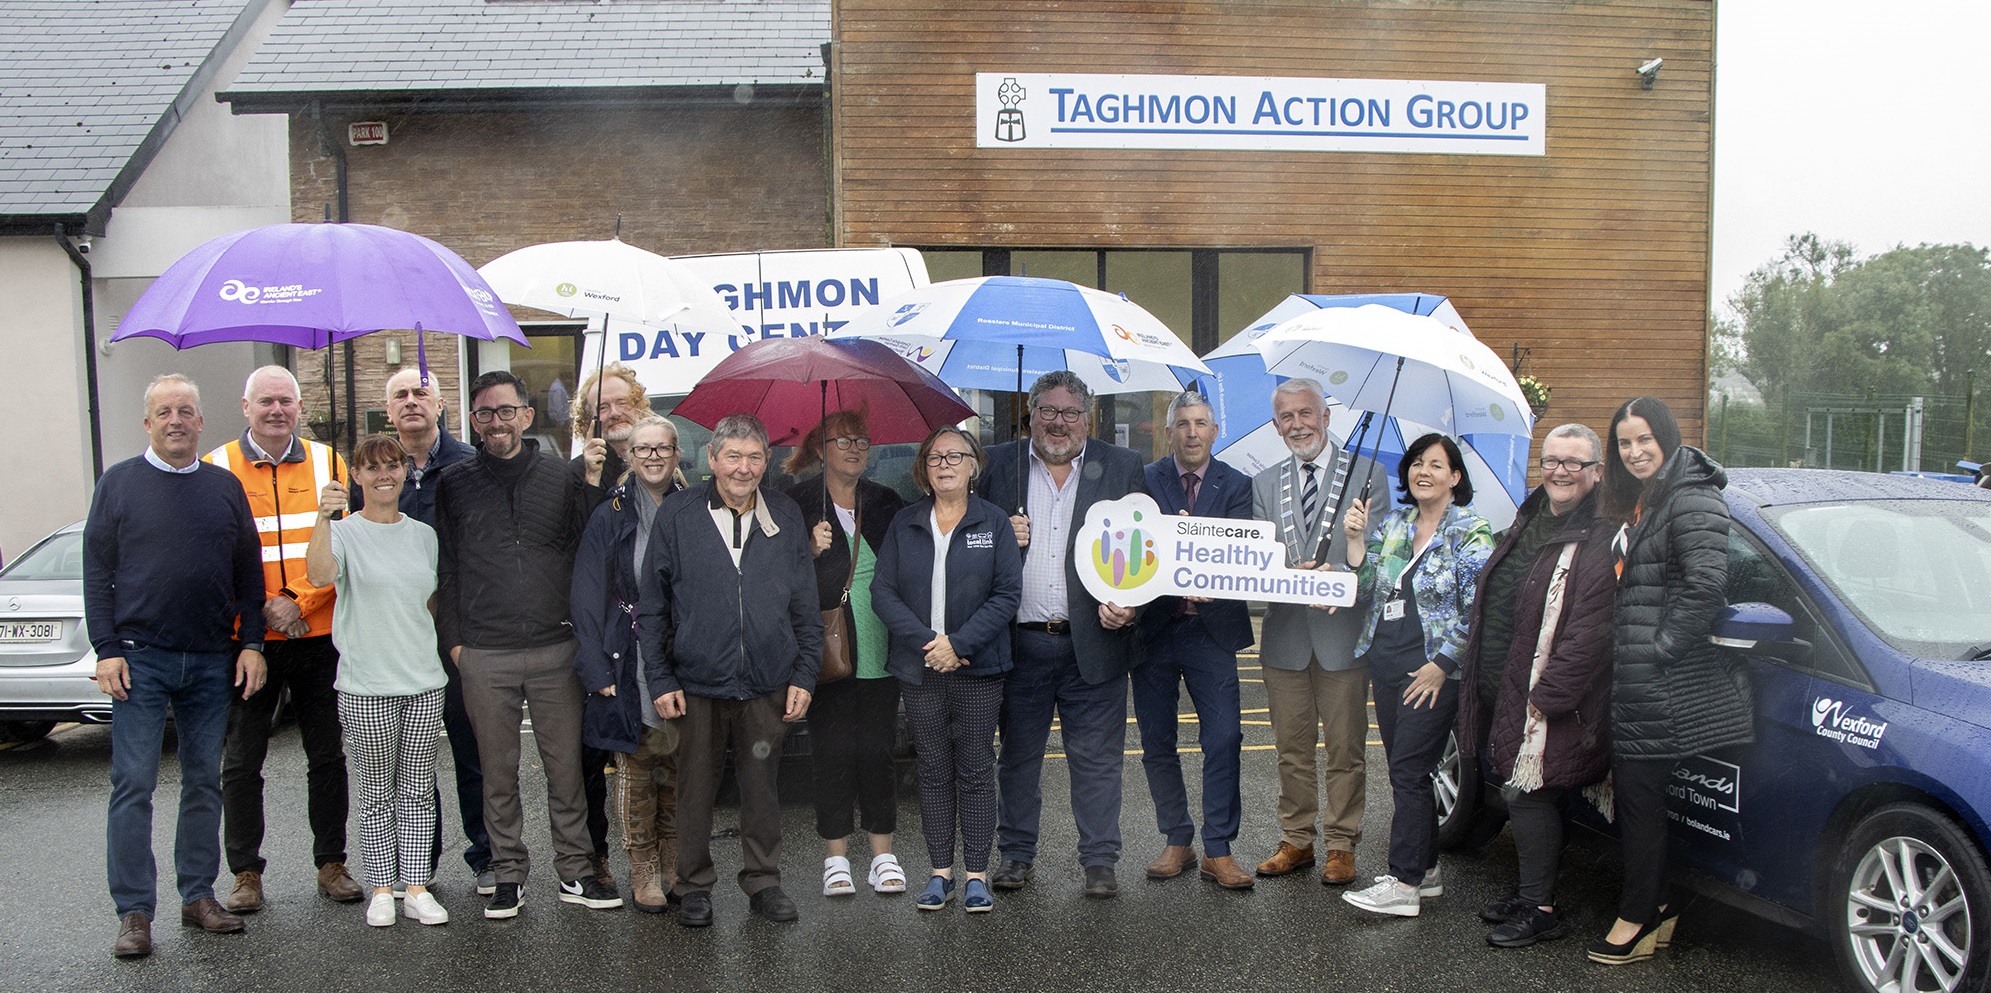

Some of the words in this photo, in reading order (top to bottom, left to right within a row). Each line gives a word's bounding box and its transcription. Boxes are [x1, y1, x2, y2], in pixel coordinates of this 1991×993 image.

[1049, 87, 1237, 125] TAGHMON
[1252, 90, 1391, 127] ACTION
[1407, 93, 1529, 130] GROUP
[584, 291, 620, 302] Wexford
[1011, 320, 1047, 329] Municipal
[1048, 324, 1075, 332] District
[619, 330, 706, 361] DAY
[1175, 540, 1273, 571] Healthy
[1173, 566, 1346, 598] Communities
[1816, 725, 1846, 743] County
[1847, 733, 1880, 749] Council
[1687, 787, 1716, 810] Town
[1686, 816, 1731, 841] bolandcars.ie
